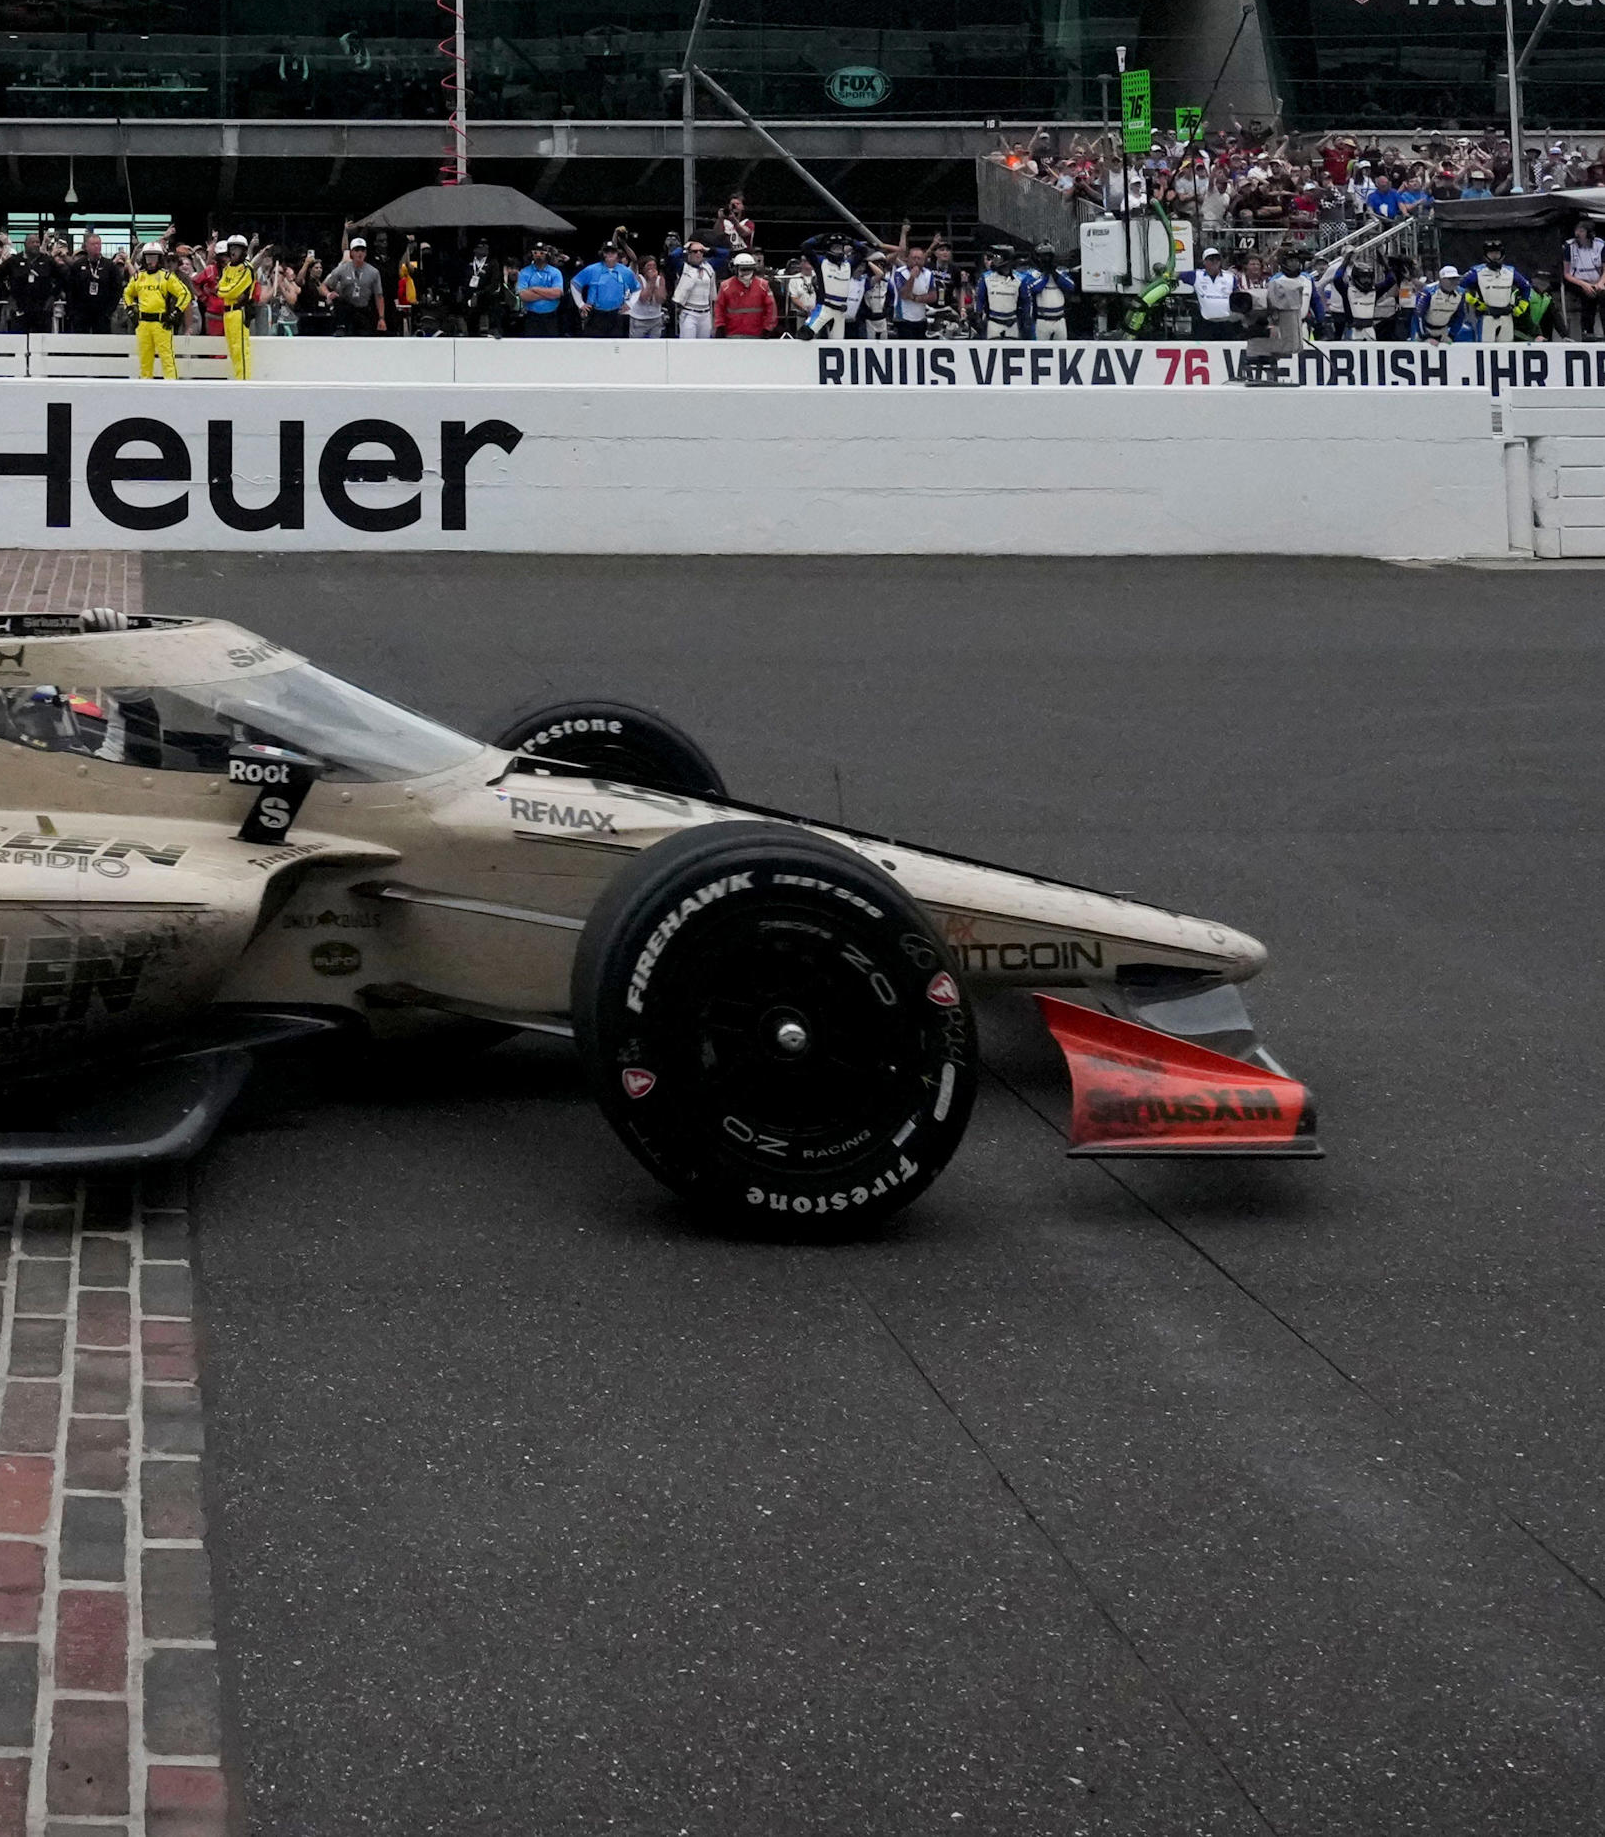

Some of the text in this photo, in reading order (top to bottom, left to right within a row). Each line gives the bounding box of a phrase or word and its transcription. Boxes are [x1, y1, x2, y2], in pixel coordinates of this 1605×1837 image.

[837, 91, 878, 99] SPORTS
[838, 74, 877, 92] FOX
[1154, 348, 1211, 386] 76
[228, 758, 291, 785] Root
[509, 796, 620, 836] REMAX
[246, 840, 333, 871] Firestone
[625, 869, 756, 1015] FIREHAWK
[801, 1127, 873, 1161] RACING
[746, 1151, 920, 1216] Firestone
